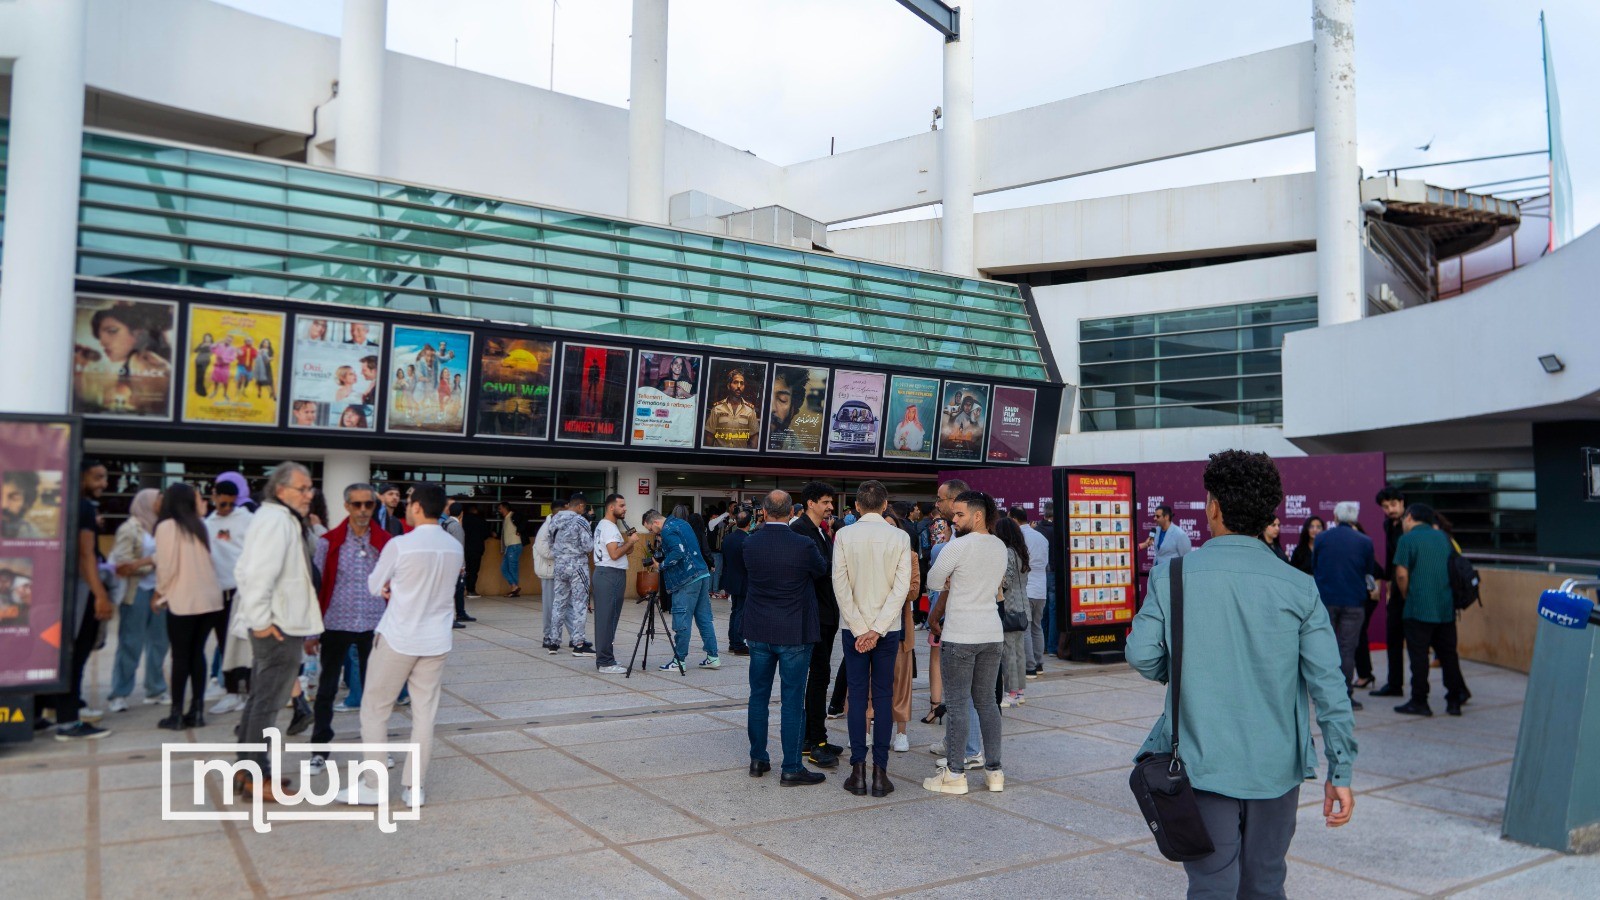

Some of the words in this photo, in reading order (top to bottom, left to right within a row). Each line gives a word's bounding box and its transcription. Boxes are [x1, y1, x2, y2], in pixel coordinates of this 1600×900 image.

[483, 381, 516, 395] CIVIL
[521, 384, 550, 396] WAR
[564, 420, 595, 433] MONKEY
[597, 422, 614, 434] MAN
[1080, 477, 1118, 486] MEGARAMA
[525, 489, 533, 499] 2
[1086, 634, 1116, 644] MEGARAMA
